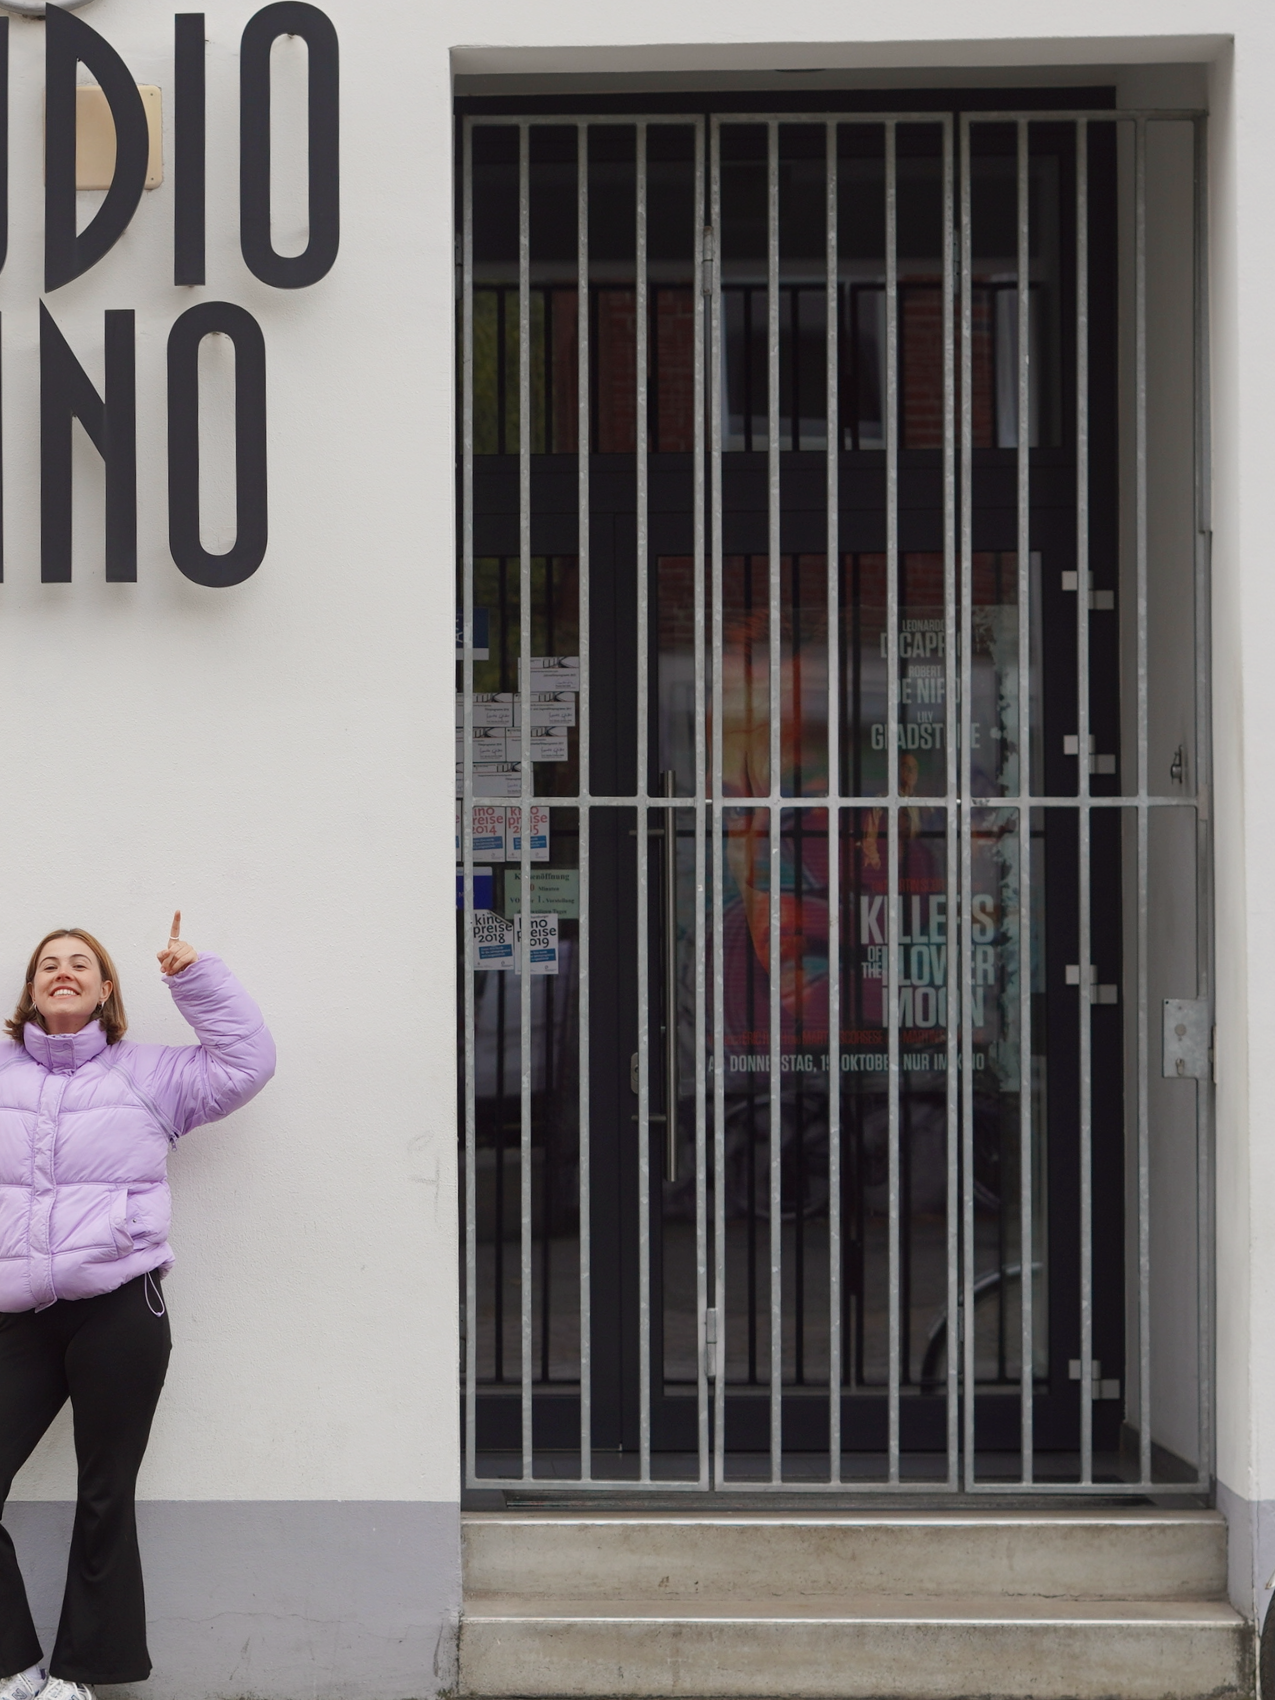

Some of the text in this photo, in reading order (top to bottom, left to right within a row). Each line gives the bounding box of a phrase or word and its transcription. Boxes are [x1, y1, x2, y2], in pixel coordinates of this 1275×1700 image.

[909, 665, 942, 677] ROBERT
[918, 711, 934, 723] LILY
[473, 815, 504, 826] reise
[478, 932, 506, 944] 2018
[529, 937, 550, 949] 019
[861, 962, 882, 979] THE
[841, 1054, 890, 1072] OKTOBE
[903, 1053, 930, 1071] NUR
